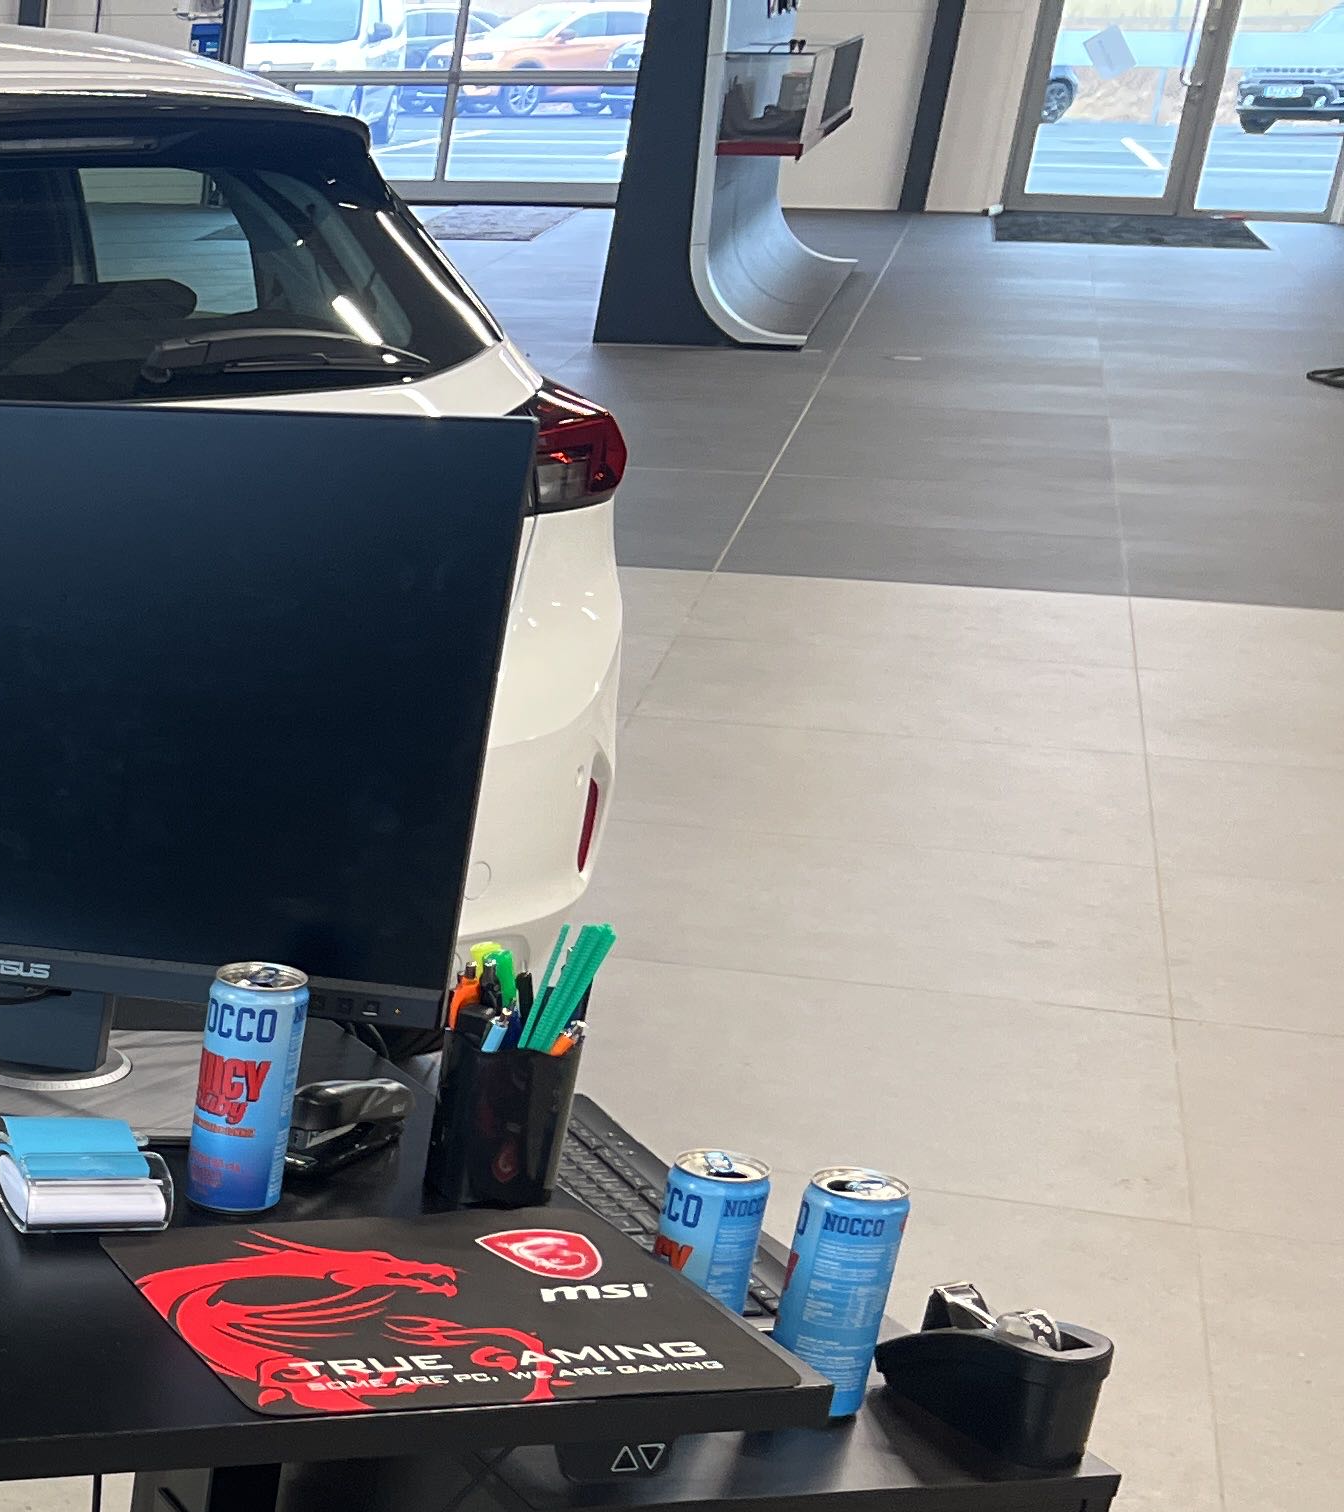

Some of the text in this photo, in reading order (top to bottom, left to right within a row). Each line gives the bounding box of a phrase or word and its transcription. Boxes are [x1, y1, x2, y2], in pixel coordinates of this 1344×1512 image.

[822, 1211, 885, 1237] NOCCO
[540, 1283, 648, 1302] msi
[287, 1341, 707, 1377] TRUE GAMING
[306, 1377, 389, 1391] SOME
[395, 1375, 450, 1386] ARE
[509, 1370, 553, 1381] WE
[559, 1366, 613, 1378] ARE
[616, 1360, 725, 1374] GAMING
